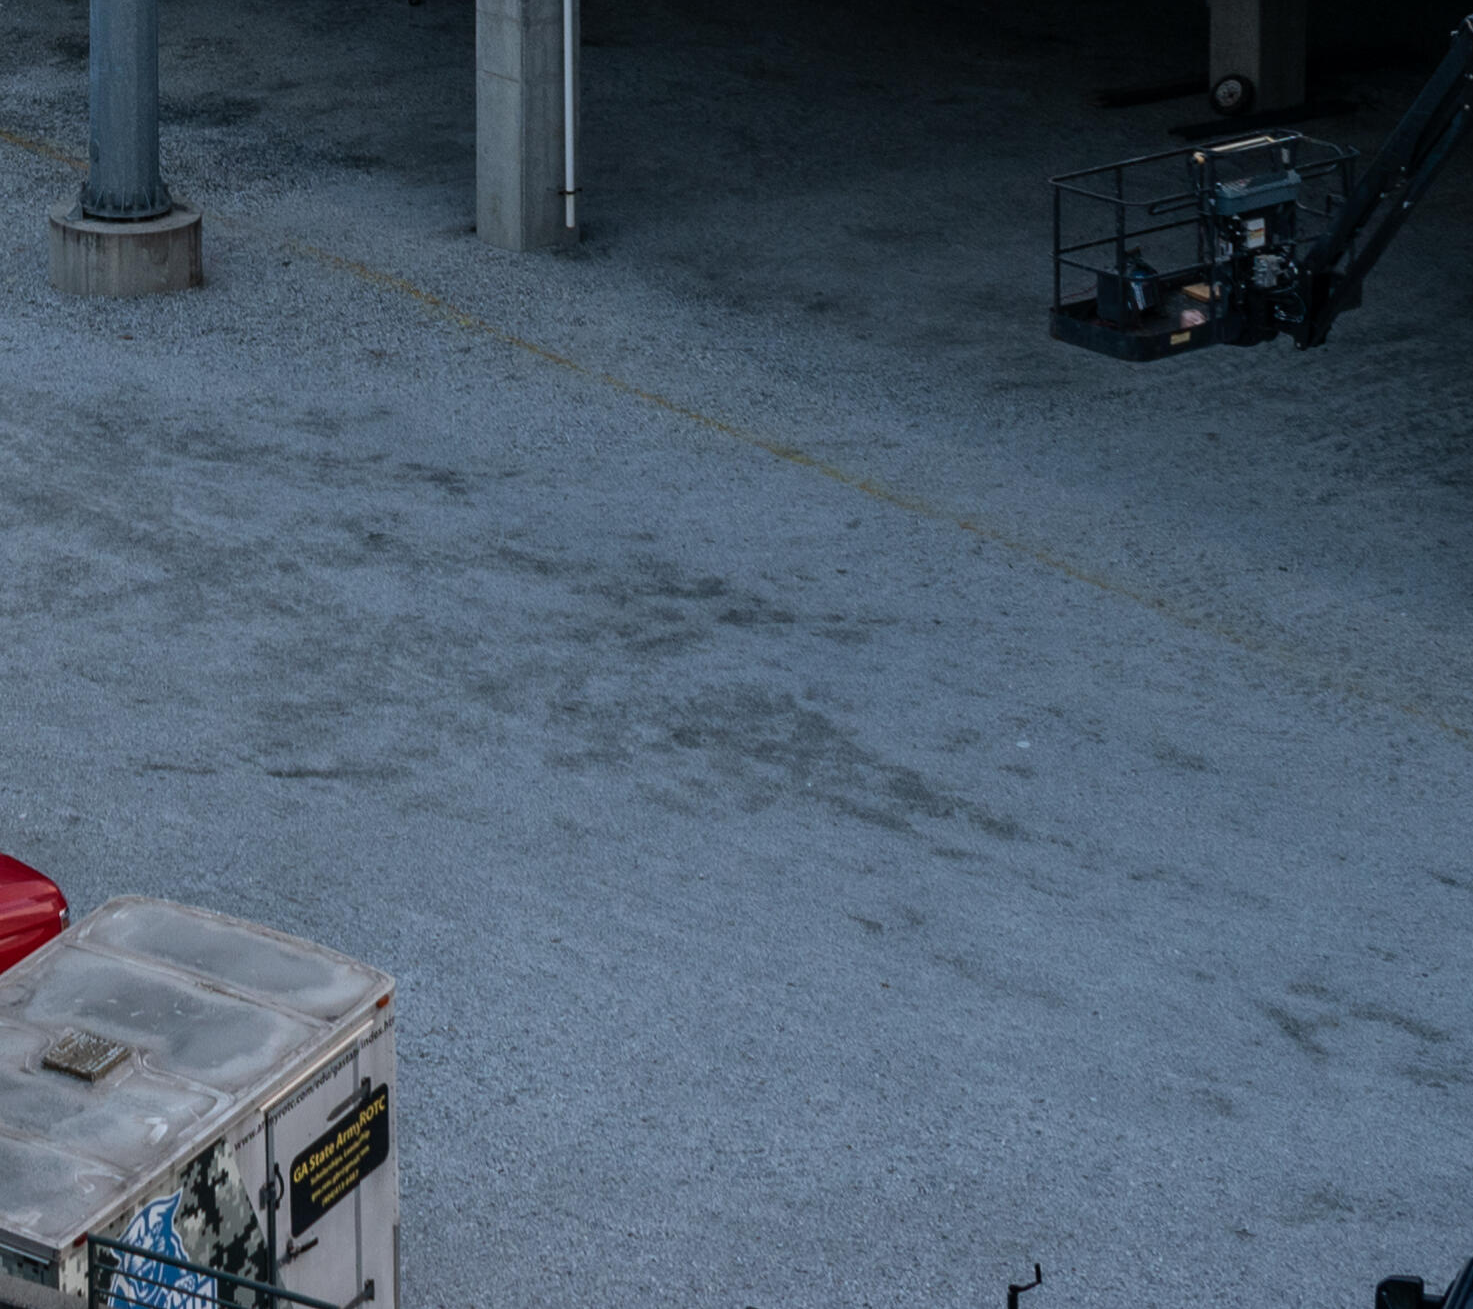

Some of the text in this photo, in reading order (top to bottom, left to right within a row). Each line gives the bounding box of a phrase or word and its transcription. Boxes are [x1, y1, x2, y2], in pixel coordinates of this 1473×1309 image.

[294, 1163, 309, 1184] GA
[309, 1143, 335, 1172] State
[336, 1094, 386, 1150] ArmyROTC
